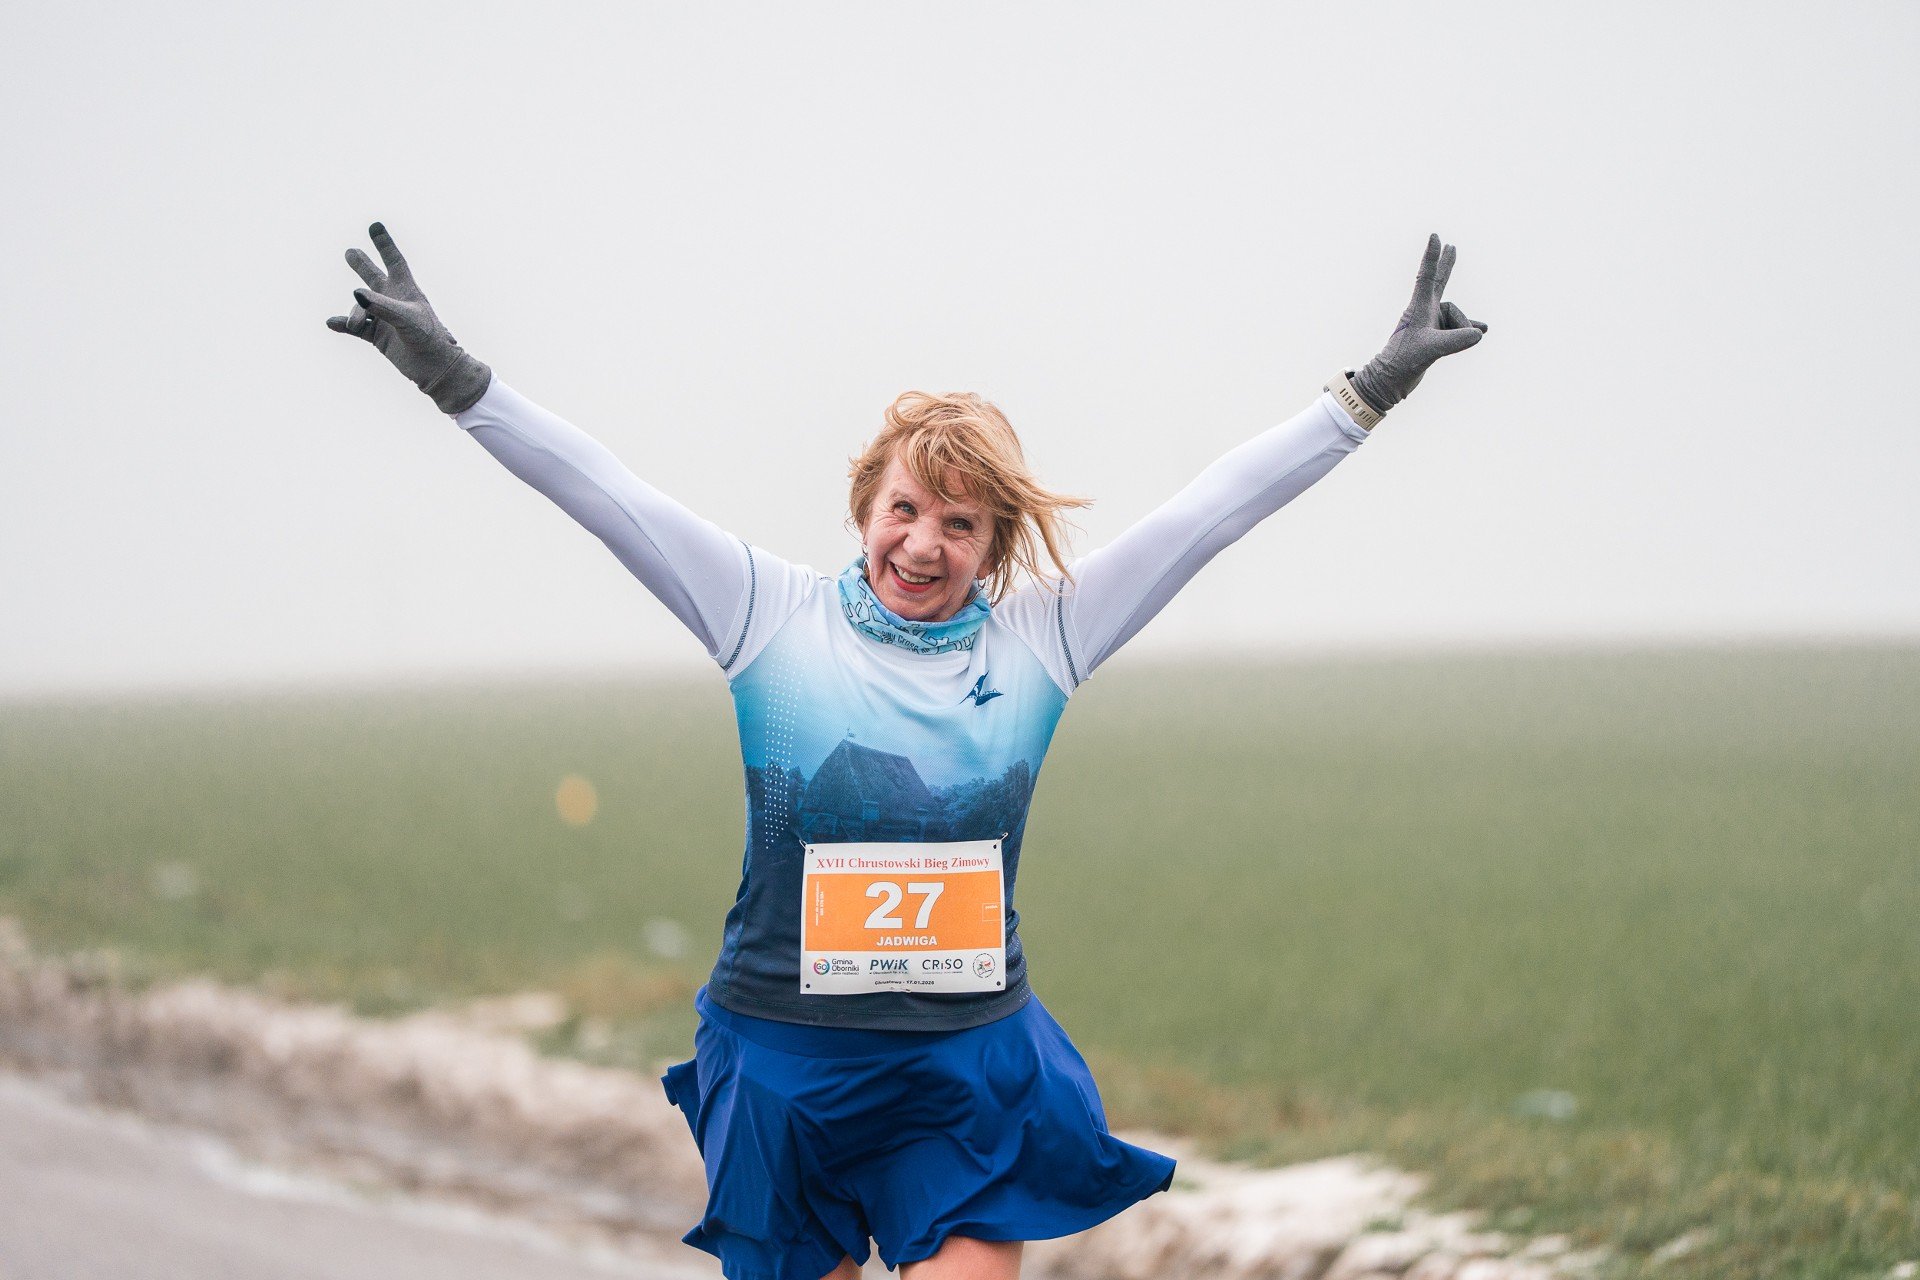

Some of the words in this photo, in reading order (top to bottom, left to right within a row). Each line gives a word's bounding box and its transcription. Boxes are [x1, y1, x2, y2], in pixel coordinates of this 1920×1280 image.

[816, 858, 845, 868] XVII
[848, 857, 921, 868] Chrustowski
[924, 858, 948, 870] Bieg
[951, 857, 990, 868] Zimowy
[863, 881, 945, 929] 27
[876, 935, 938, 946] JADWIGA
[869, 959, 909, 971] PWiK
